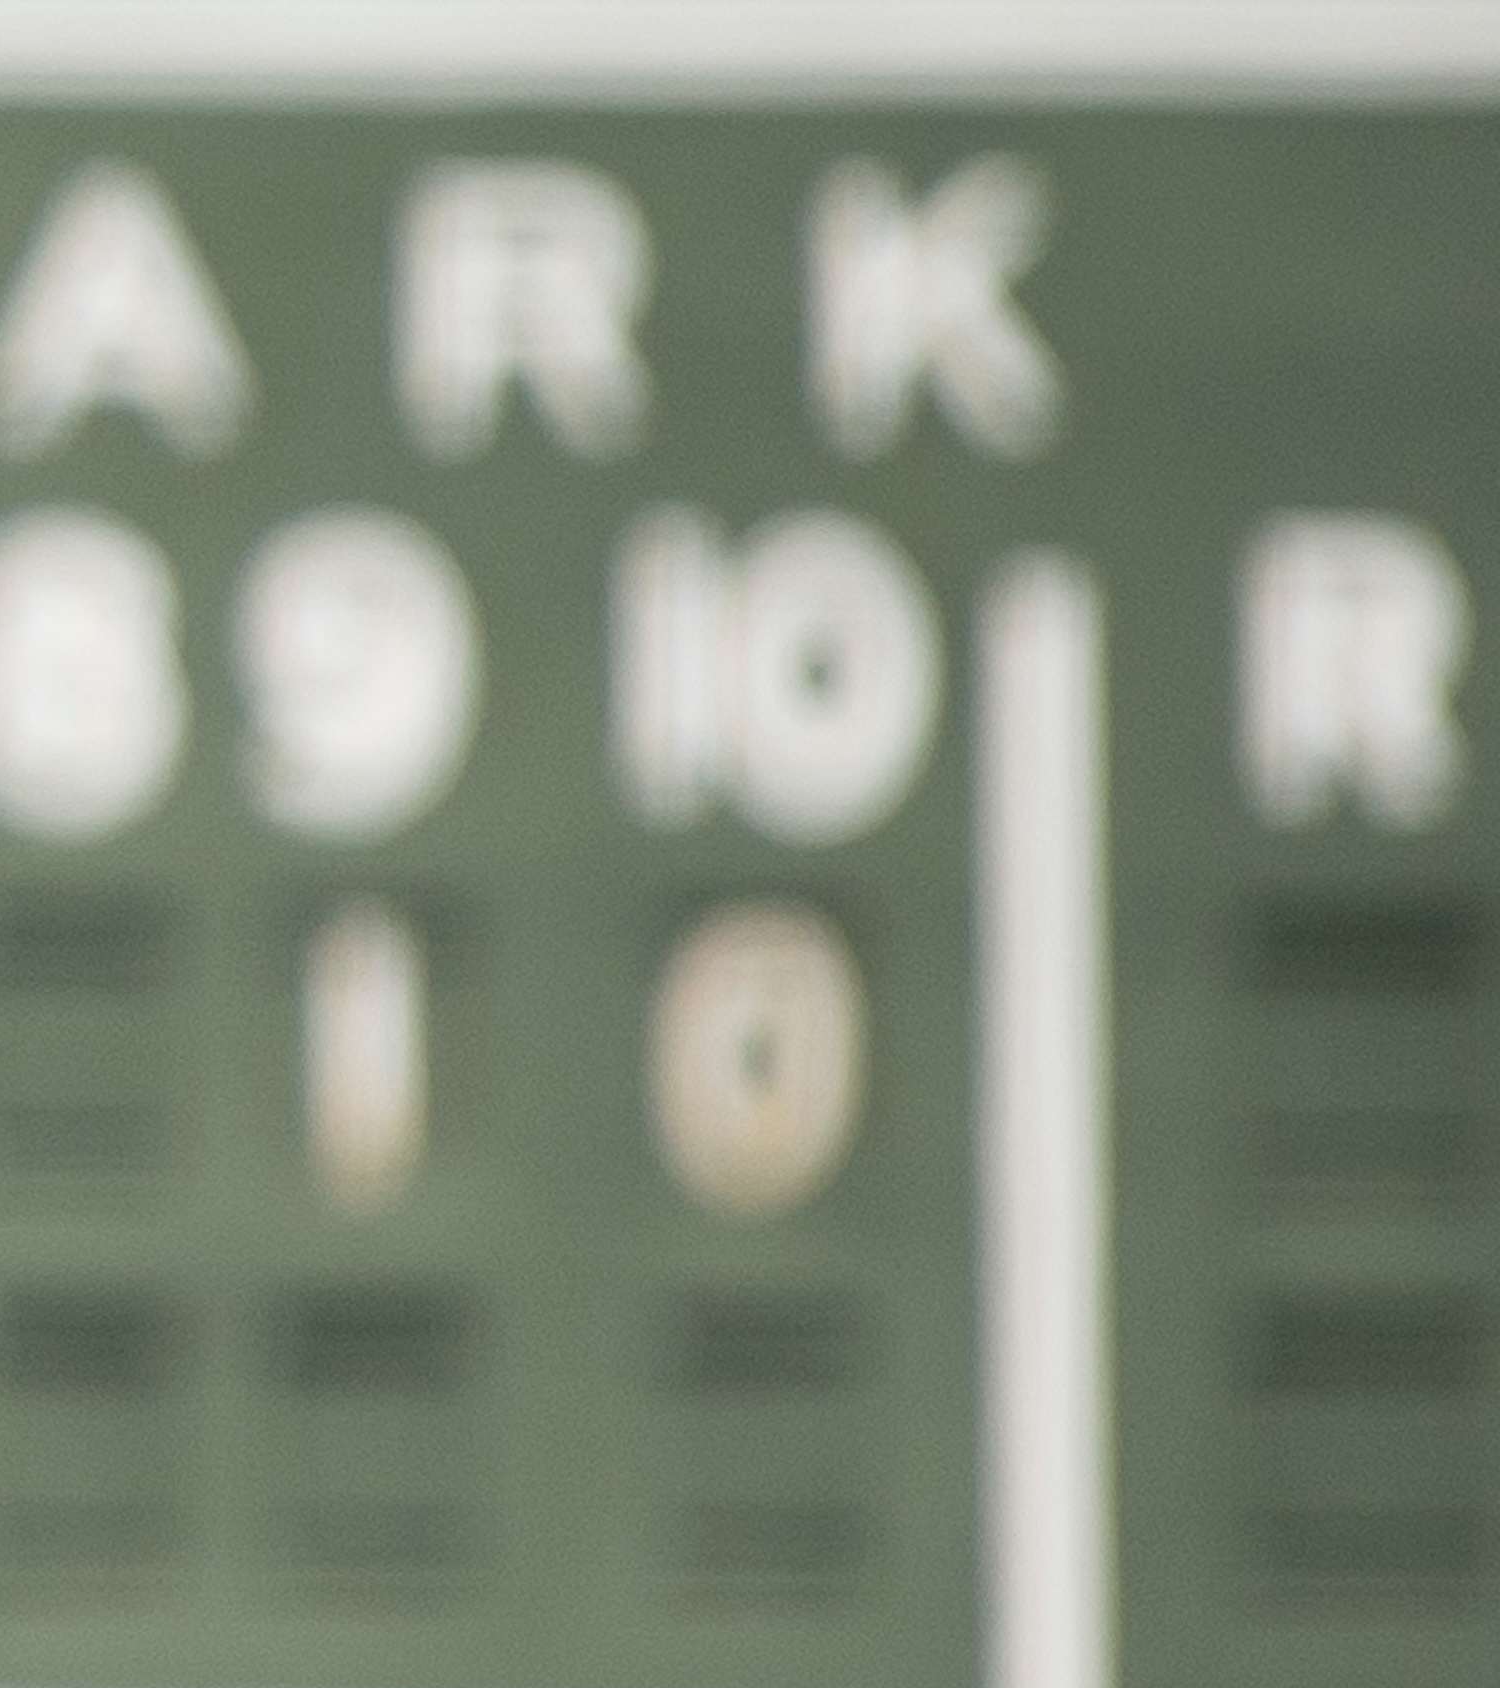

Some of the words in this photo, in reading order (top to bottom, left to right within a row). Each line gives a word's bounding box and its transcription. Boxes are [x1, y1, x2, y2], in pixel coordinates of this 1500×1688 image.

[235, 512, 478, 840] 9
[610, 510, 942, 844] 10
[1236, 512, 1470, 826] R
